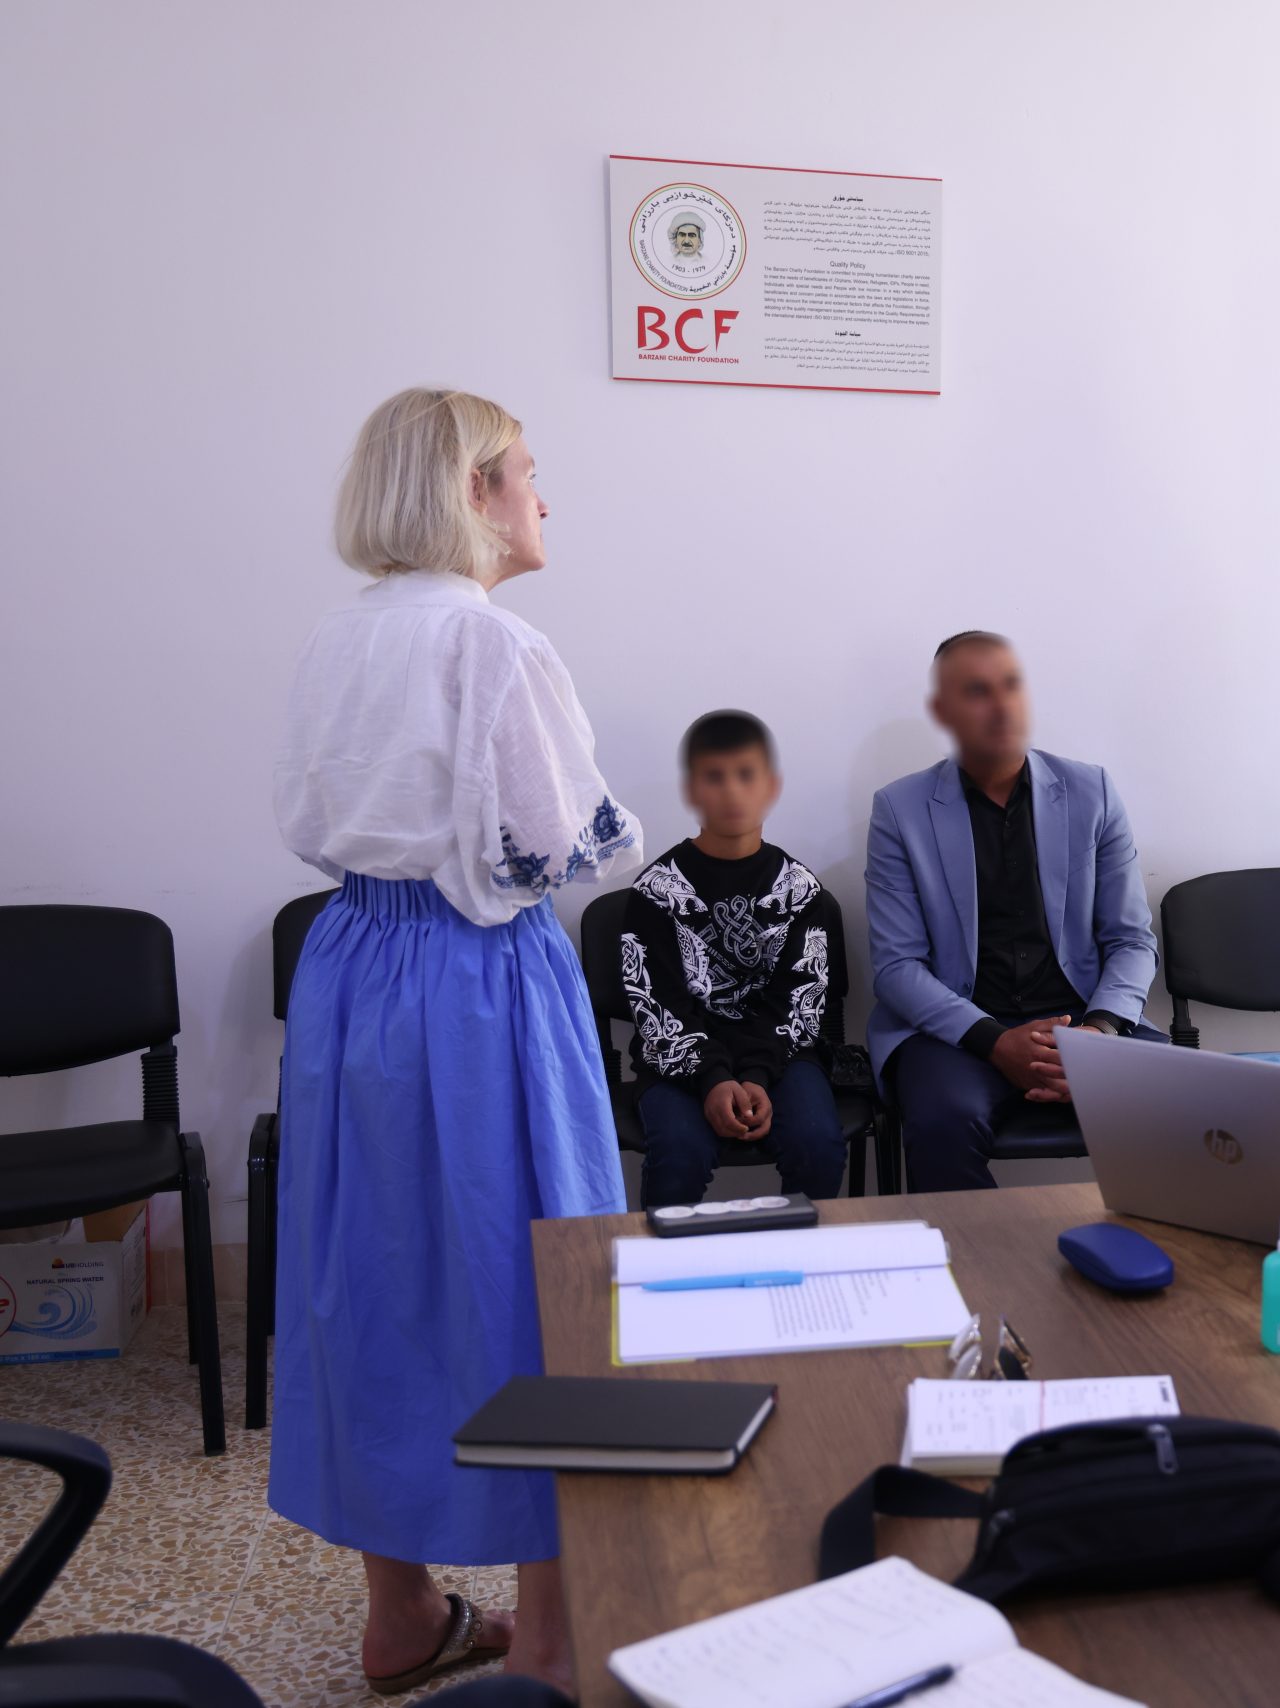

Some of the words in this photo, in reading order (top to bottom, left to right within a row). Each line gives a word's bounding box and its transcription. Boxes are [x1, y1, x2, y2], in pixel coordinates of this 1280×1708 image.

[672, 264, 685, 272] 1903
[660, 274, 688, 292] FOUNDATION
[637, 305, 740, 354] BCF
[697, 356, 740, 364] FOUNDATION
